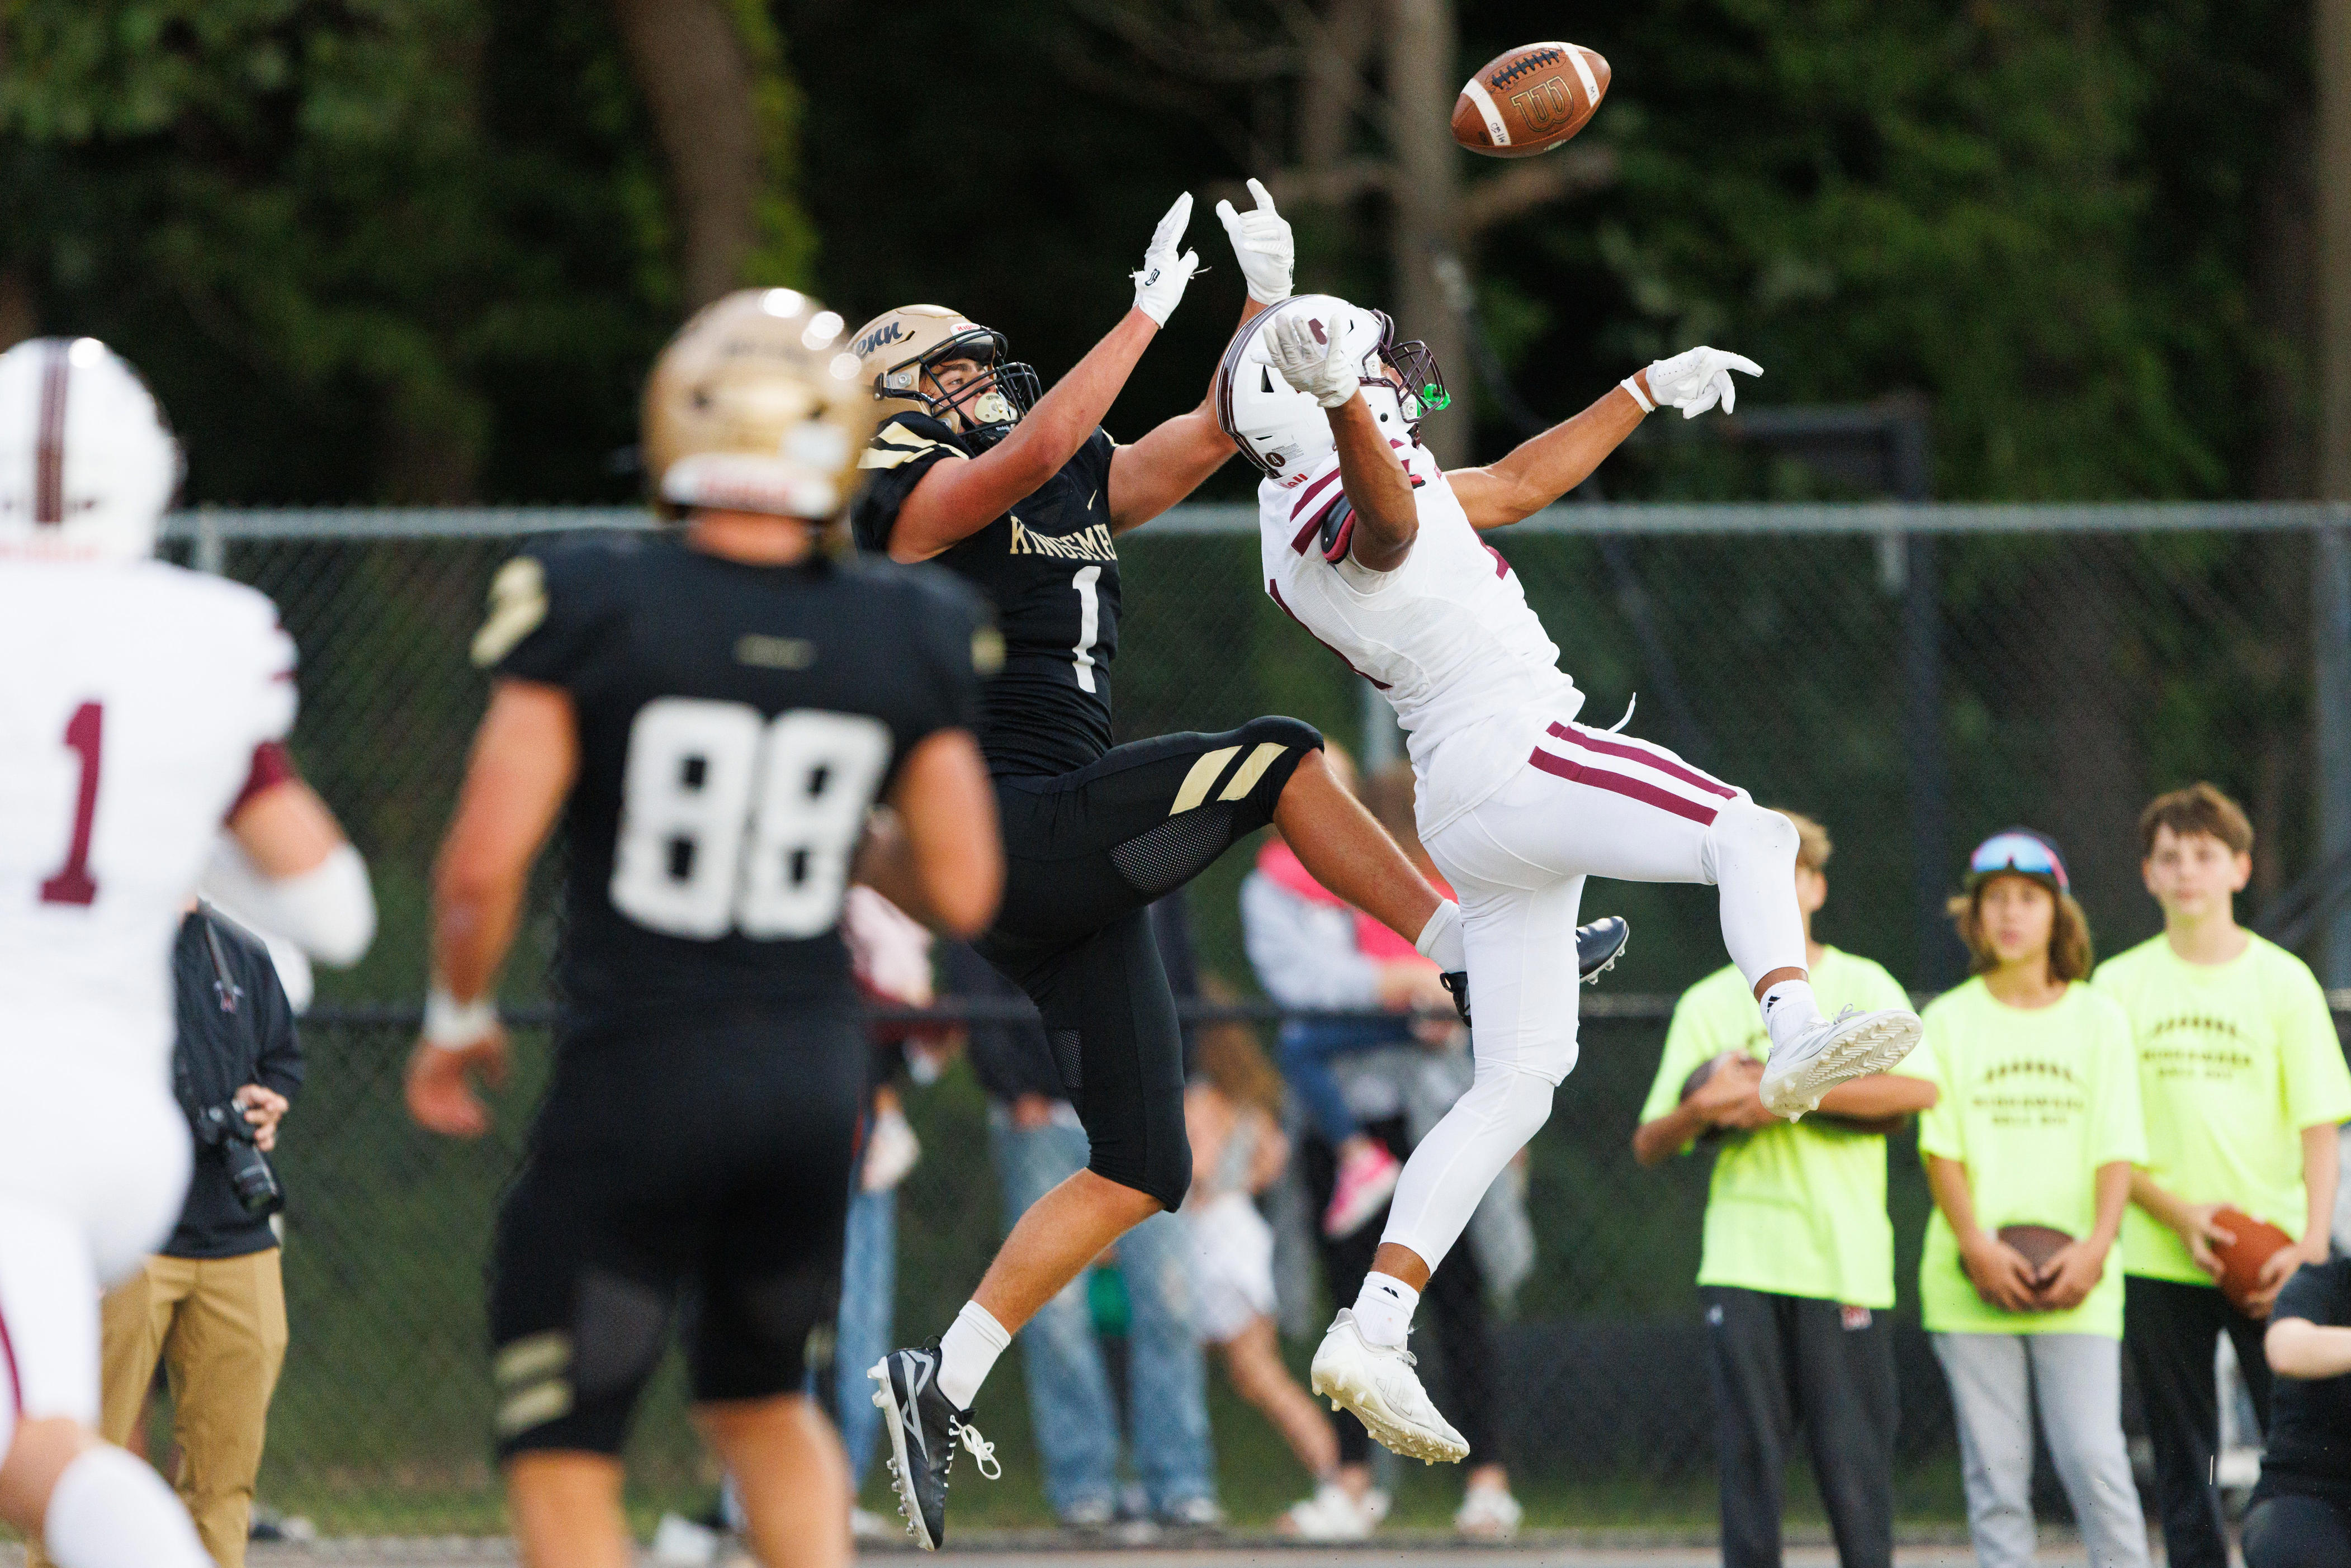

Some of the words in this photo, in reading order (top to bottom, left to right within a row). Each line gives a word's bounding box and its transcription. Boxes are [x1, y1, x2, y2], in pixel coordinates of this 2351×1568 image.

[856, 321, 903, 359] enn
[1270, 454, 1282, 465] 4
[1010, 515, 1118, 561] KINGSME
[1072, 565, 1101, 694] 1
[40, 702, 103, 906] 1
[609, 695, 893, 941] 88
